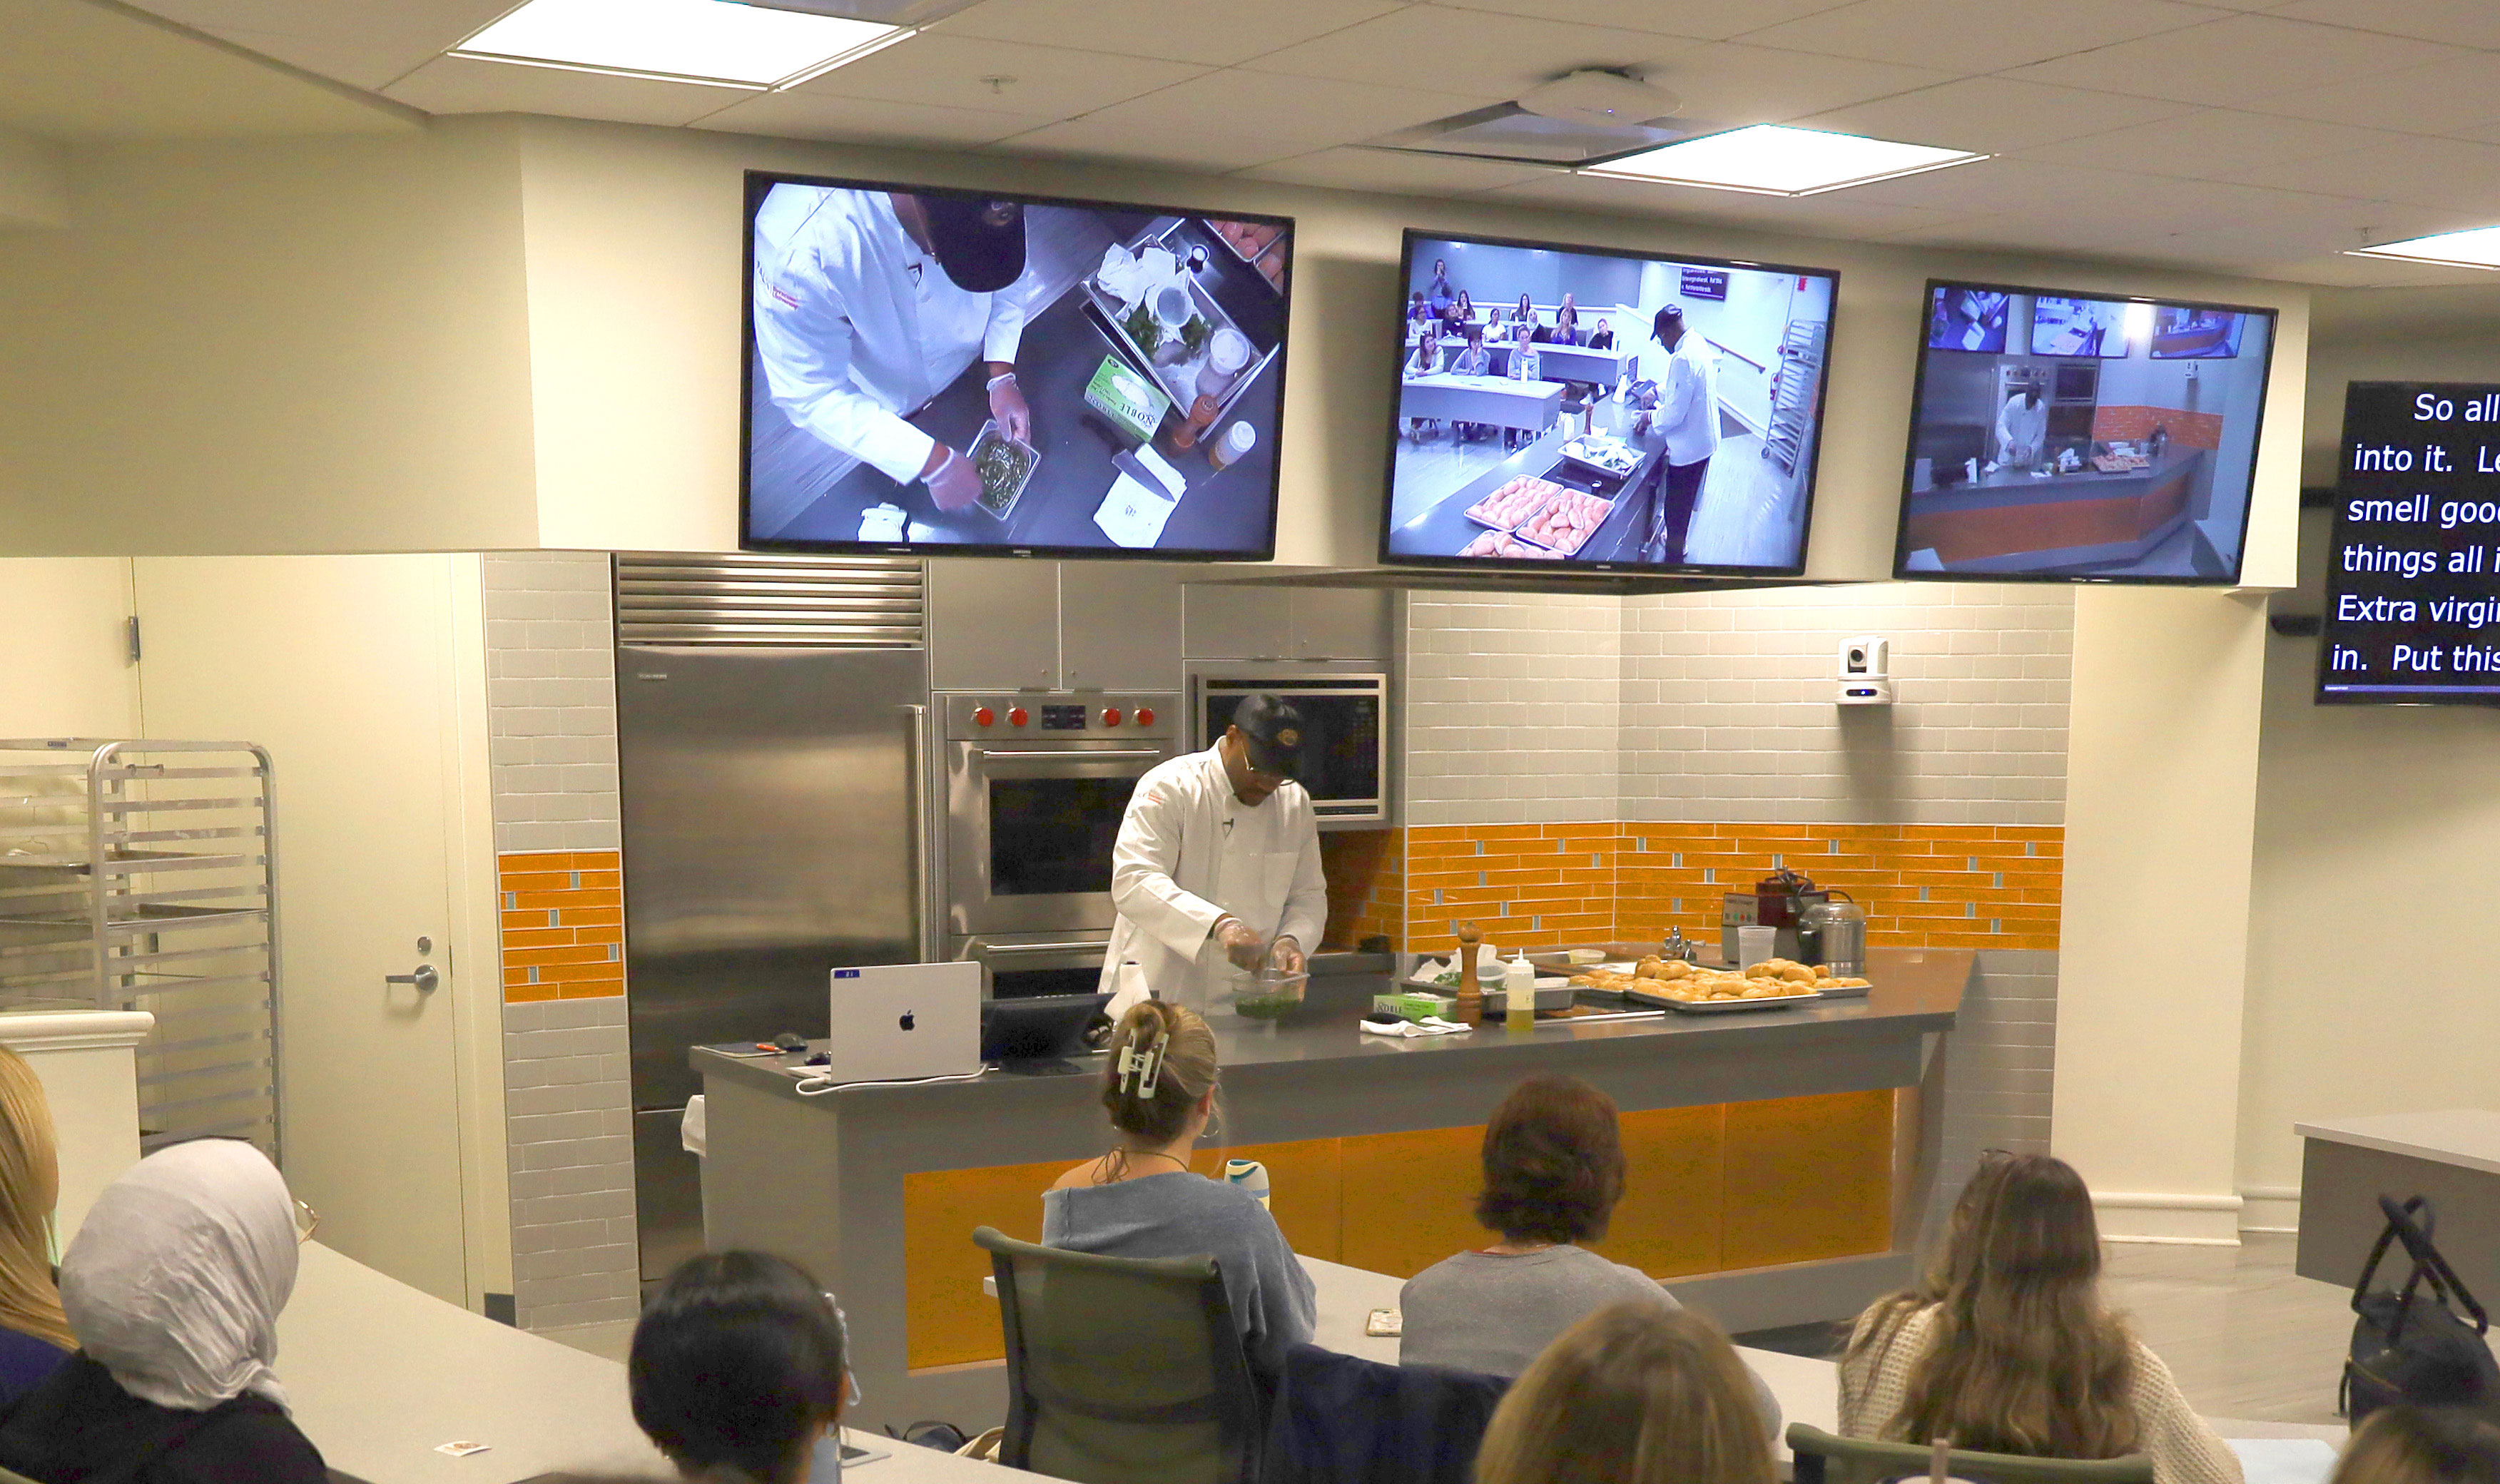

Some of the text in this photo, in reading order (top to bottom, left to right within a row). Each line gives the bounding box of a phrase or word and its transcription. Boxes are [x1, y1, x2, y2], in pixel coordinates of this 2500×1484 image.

[1119, 402, 1154, 426] NOBLE
[2414, 393, 2500, 422] So all
[2354, 443, 2413, 472] into
[2424, 444, 2453, 472] it.
[2347, 494, 2500, 529] smell goo
[2343, 544, 2437, 579] things
[2448, 545, 2484, 573] all
[2337, 594, 2417, 622] Extra
[2332, 644, 2368, 671] in.
[2392, 644, 2443, 671] Put
